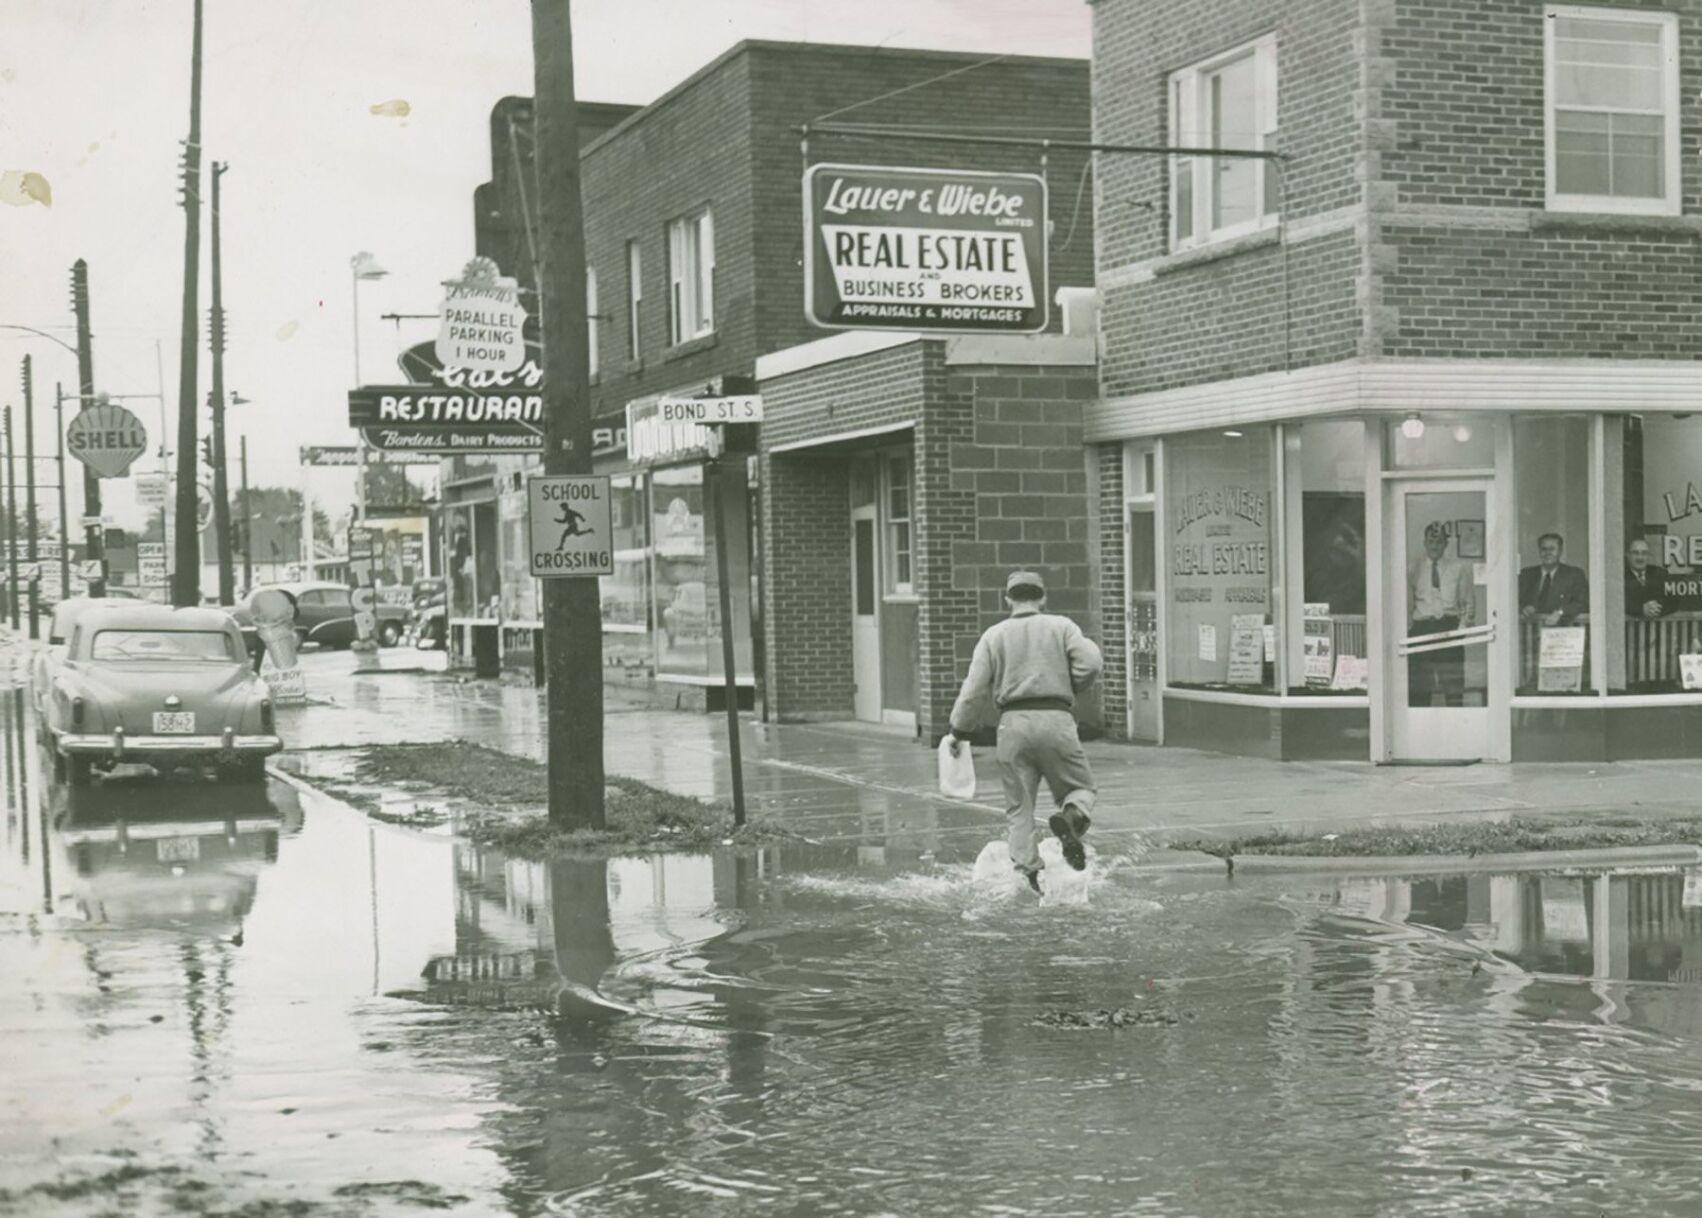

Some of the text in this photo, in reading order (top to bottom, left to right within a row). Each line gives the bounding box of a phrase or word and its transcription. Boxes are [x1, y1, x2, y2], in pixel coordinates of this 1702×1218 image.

[824, 178, 1024, 217] Lauer & Wiebe
[835, 231, 1017, 273] REAL ESTATE
[919, 272, 942, 281] AND
[843, 280, 1024, 302] BUSINESS BROKERS
[446, 309, 518, 328] PARALLEL
[841, 303, 921, 319] APPRAISALS
[941, 307, 1023, 322] MORTGAGES
[450, 327, 514, 345] PARKING
[467, 347, 506, 361] HOUR
[664, 404, 706, 421] BOND
[74, 430, 143, 450] SHELL
[451, 433, 484, 447] DAIRY
[488, 433, 542, 446] PRODUCTS
[542, 484, 600, 501] SCHOOL
[535, 552, 609, 569] CROSSING
[1174, 541, 1266, 576] REAL ESTATE
[1662, 535, 1702, 568] RE
